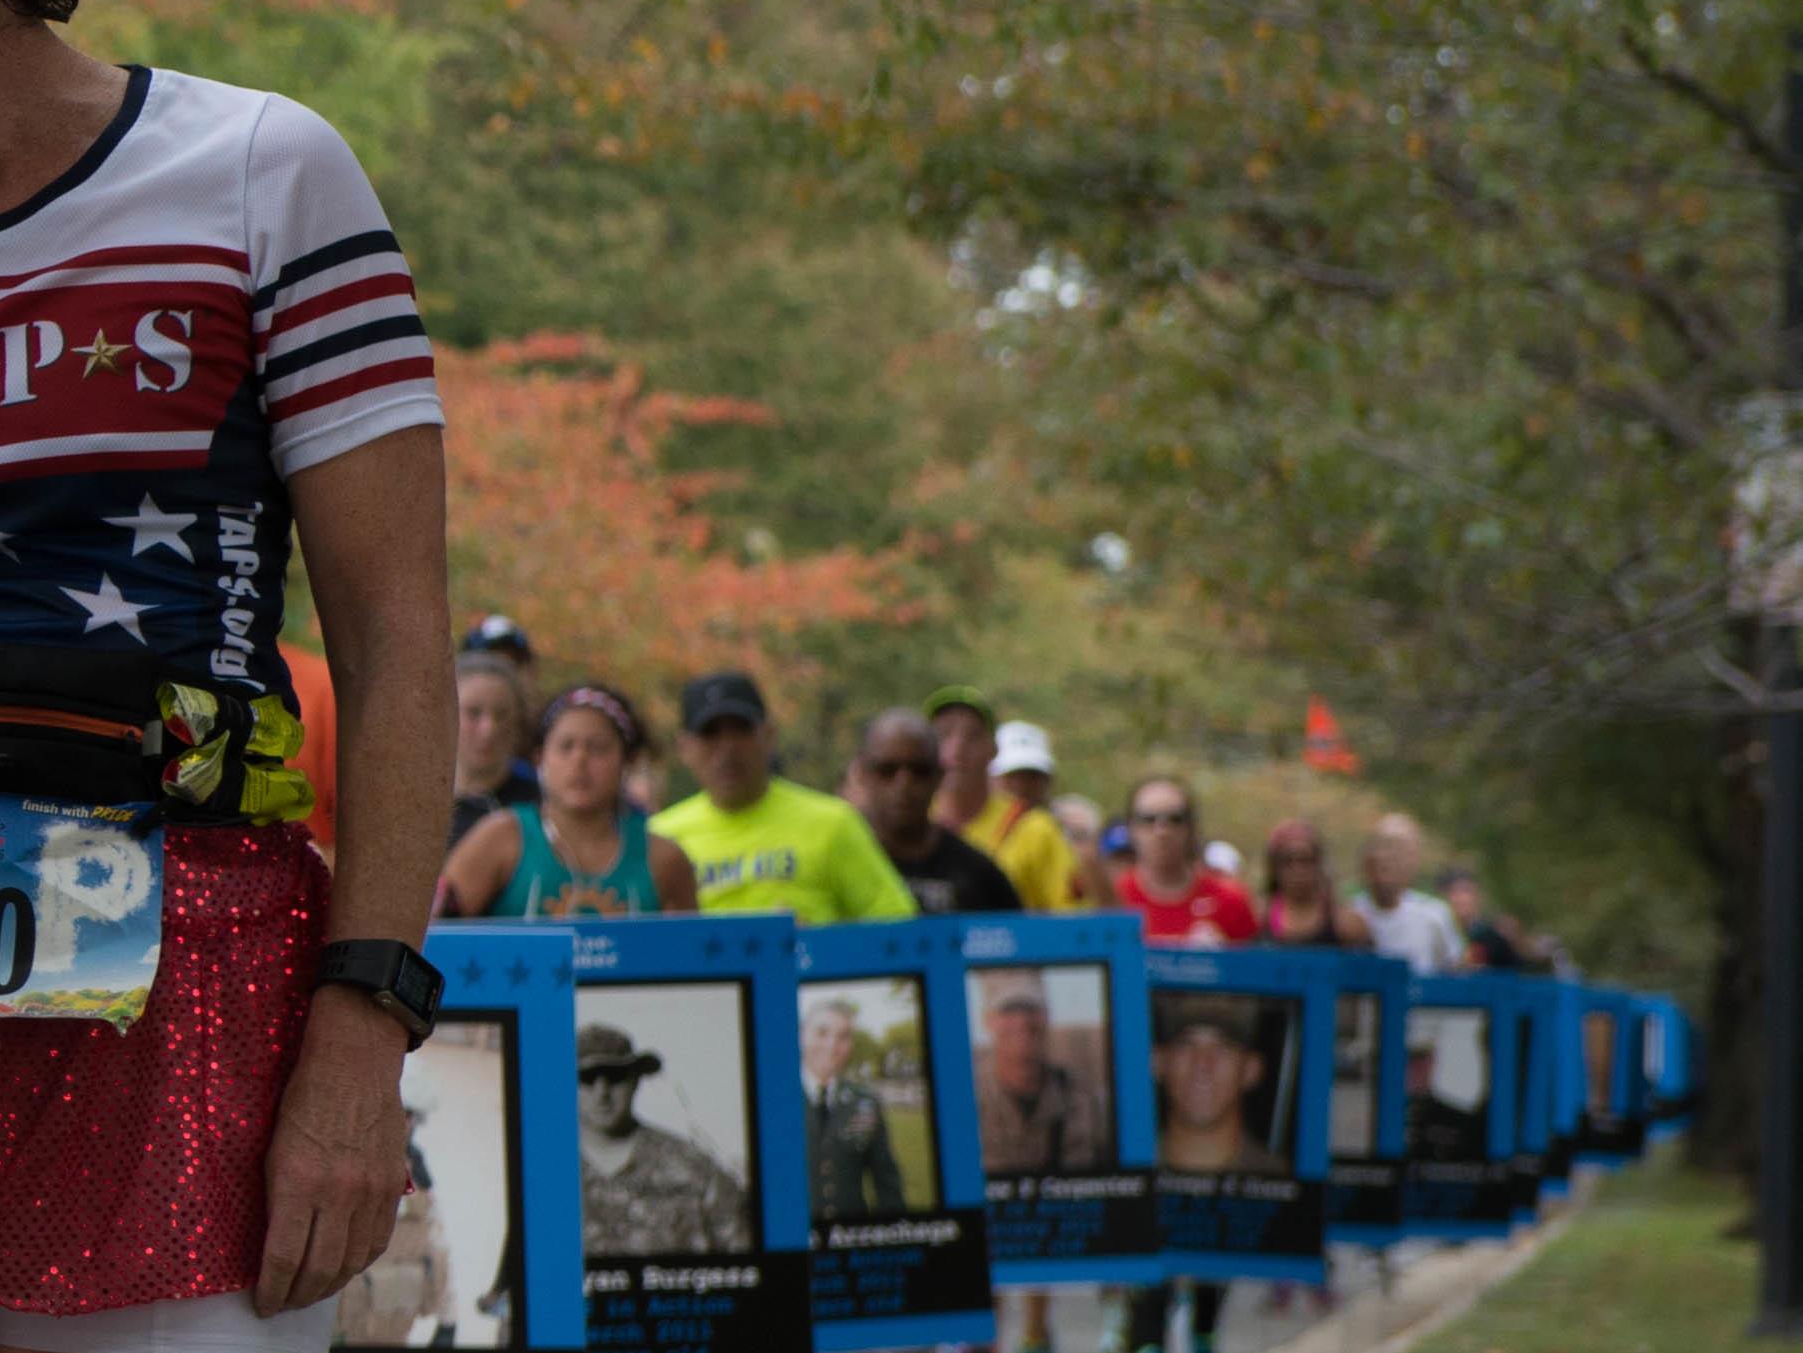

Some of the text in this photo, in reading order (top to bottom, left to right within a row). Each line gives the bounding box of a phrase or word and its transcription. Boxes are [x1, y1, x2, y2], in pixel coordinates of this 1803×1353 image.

[210, 501, 267, 693] TAPS.org
[22, 799, 58, 816] finish
[62, 805, 89, 819] with
